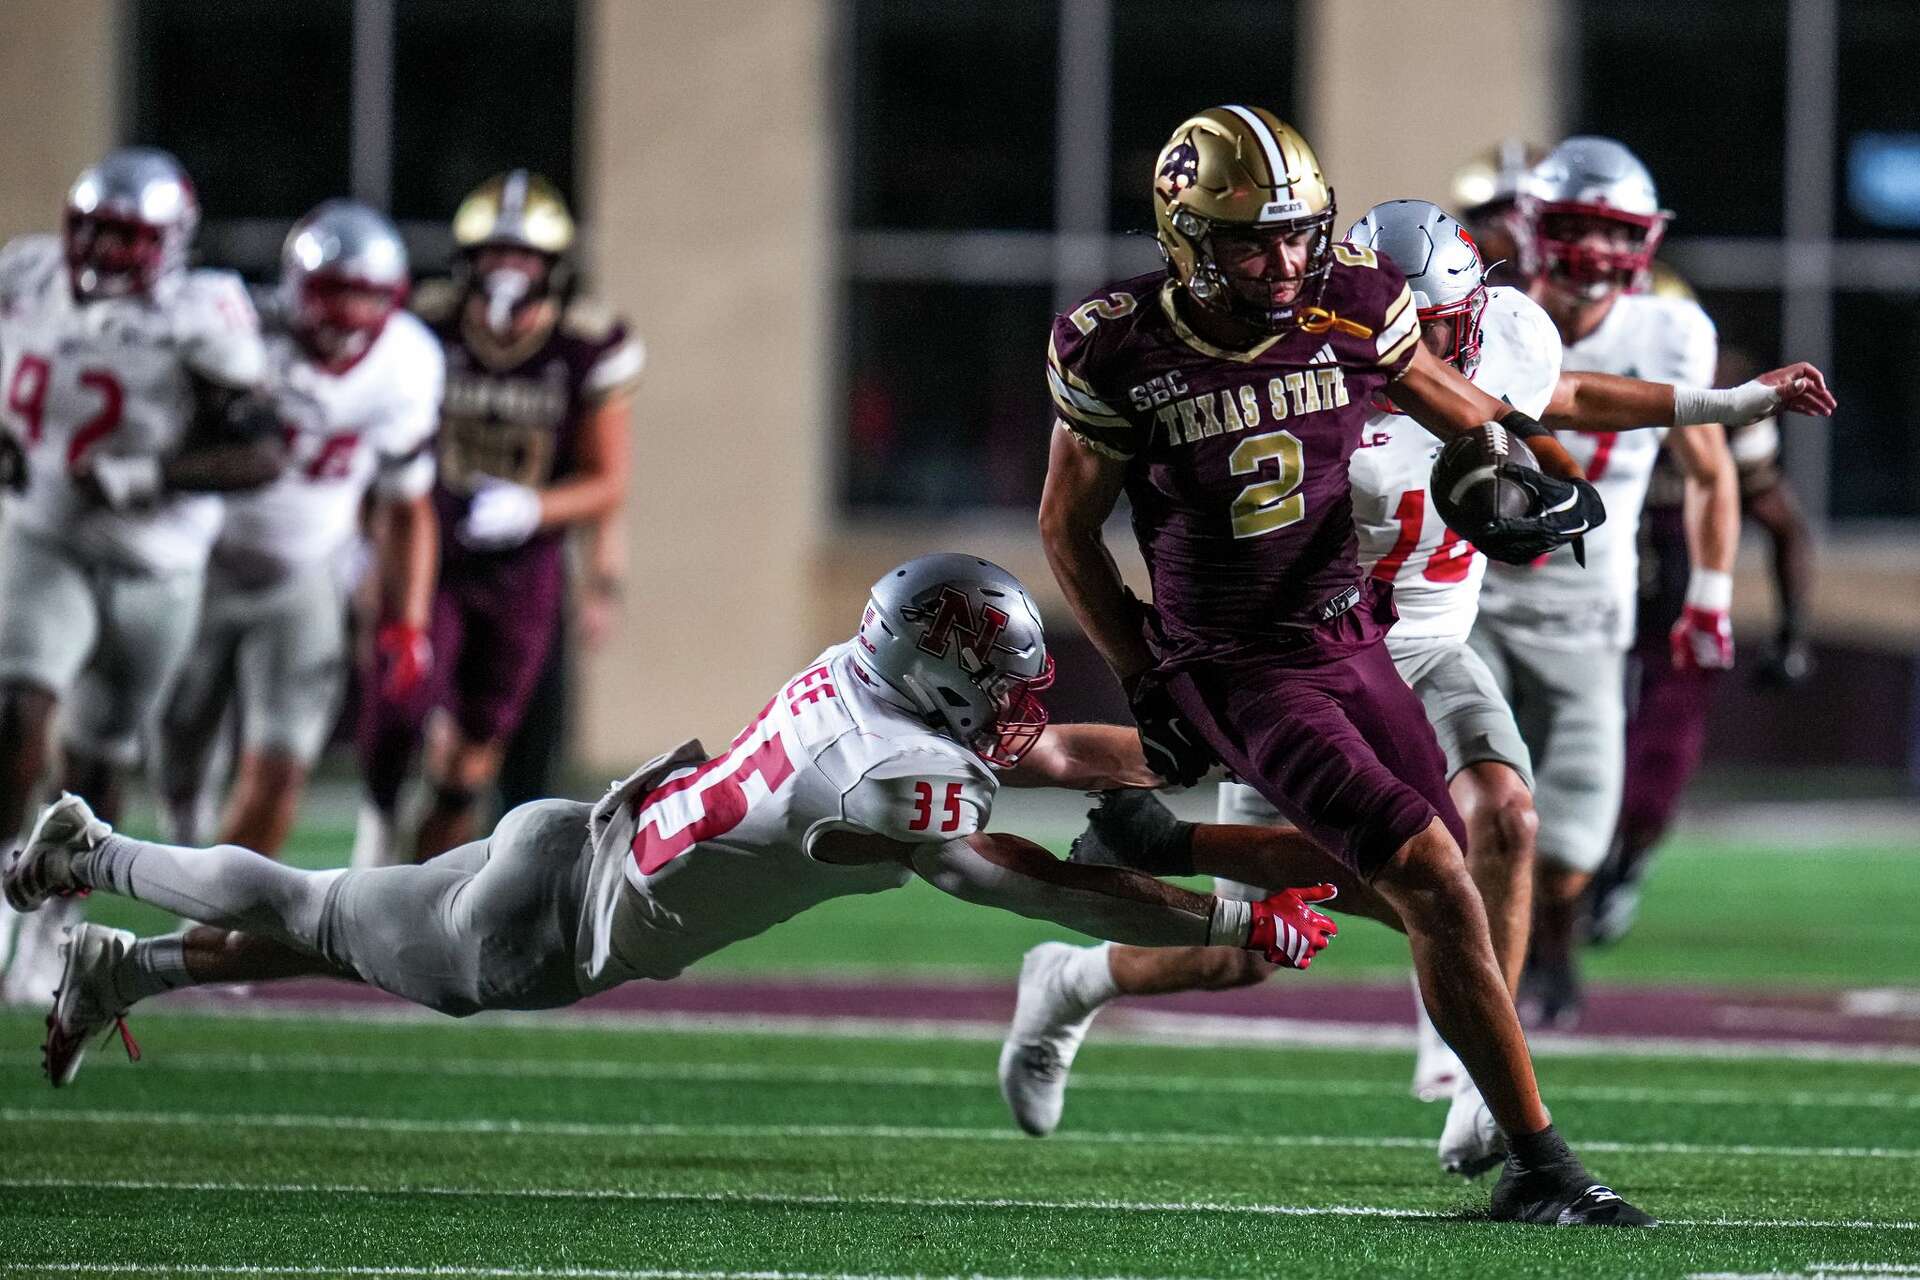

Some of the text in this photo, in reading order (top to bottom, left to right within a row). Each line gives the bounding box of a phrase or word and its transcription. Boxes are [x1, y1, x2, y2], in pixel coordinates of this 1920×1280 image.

[1267, 202, 1302, 215] BOBCATS
[1069, 292, 1138, 337] 2
[1129, 369, 1189, 412] SBC
[1157, 366, 1350, 446] TEXAS STATE
[1229, 429, 1305, 540] 2
[916, 583, 1010, 674] N
[785, 665, 837, 718] EE
[908, 780, 964, 833] 35
